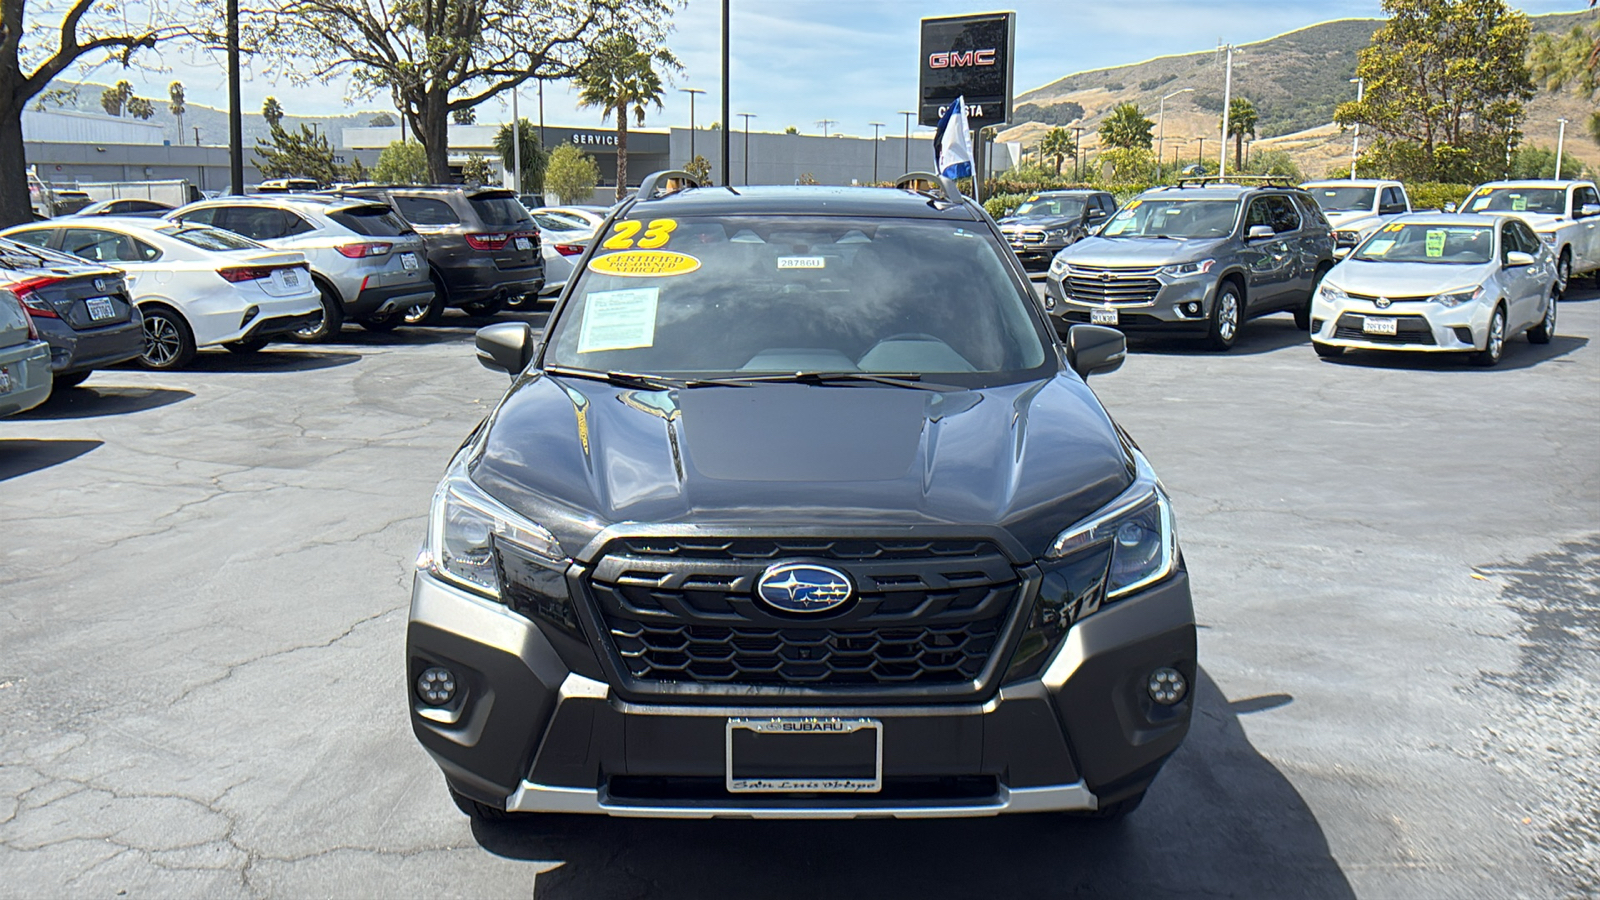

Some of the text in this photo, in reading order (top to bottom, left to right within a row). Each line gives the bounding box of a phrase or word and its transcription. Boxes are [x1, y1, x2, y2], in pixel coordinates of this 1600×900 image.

[929, 48, 996, 69] GMC
[938, 104, 983, 118] CSTA
[573, 133, 619, 146] SERVICE
[603, 218, 677, 249] 23
[606, 255, 684, 264] CERTIFIED
[782, 722, 843, 732] SUBARU
[733, 780, 774, 789] San
[778, 781, 819, 789] Luis
